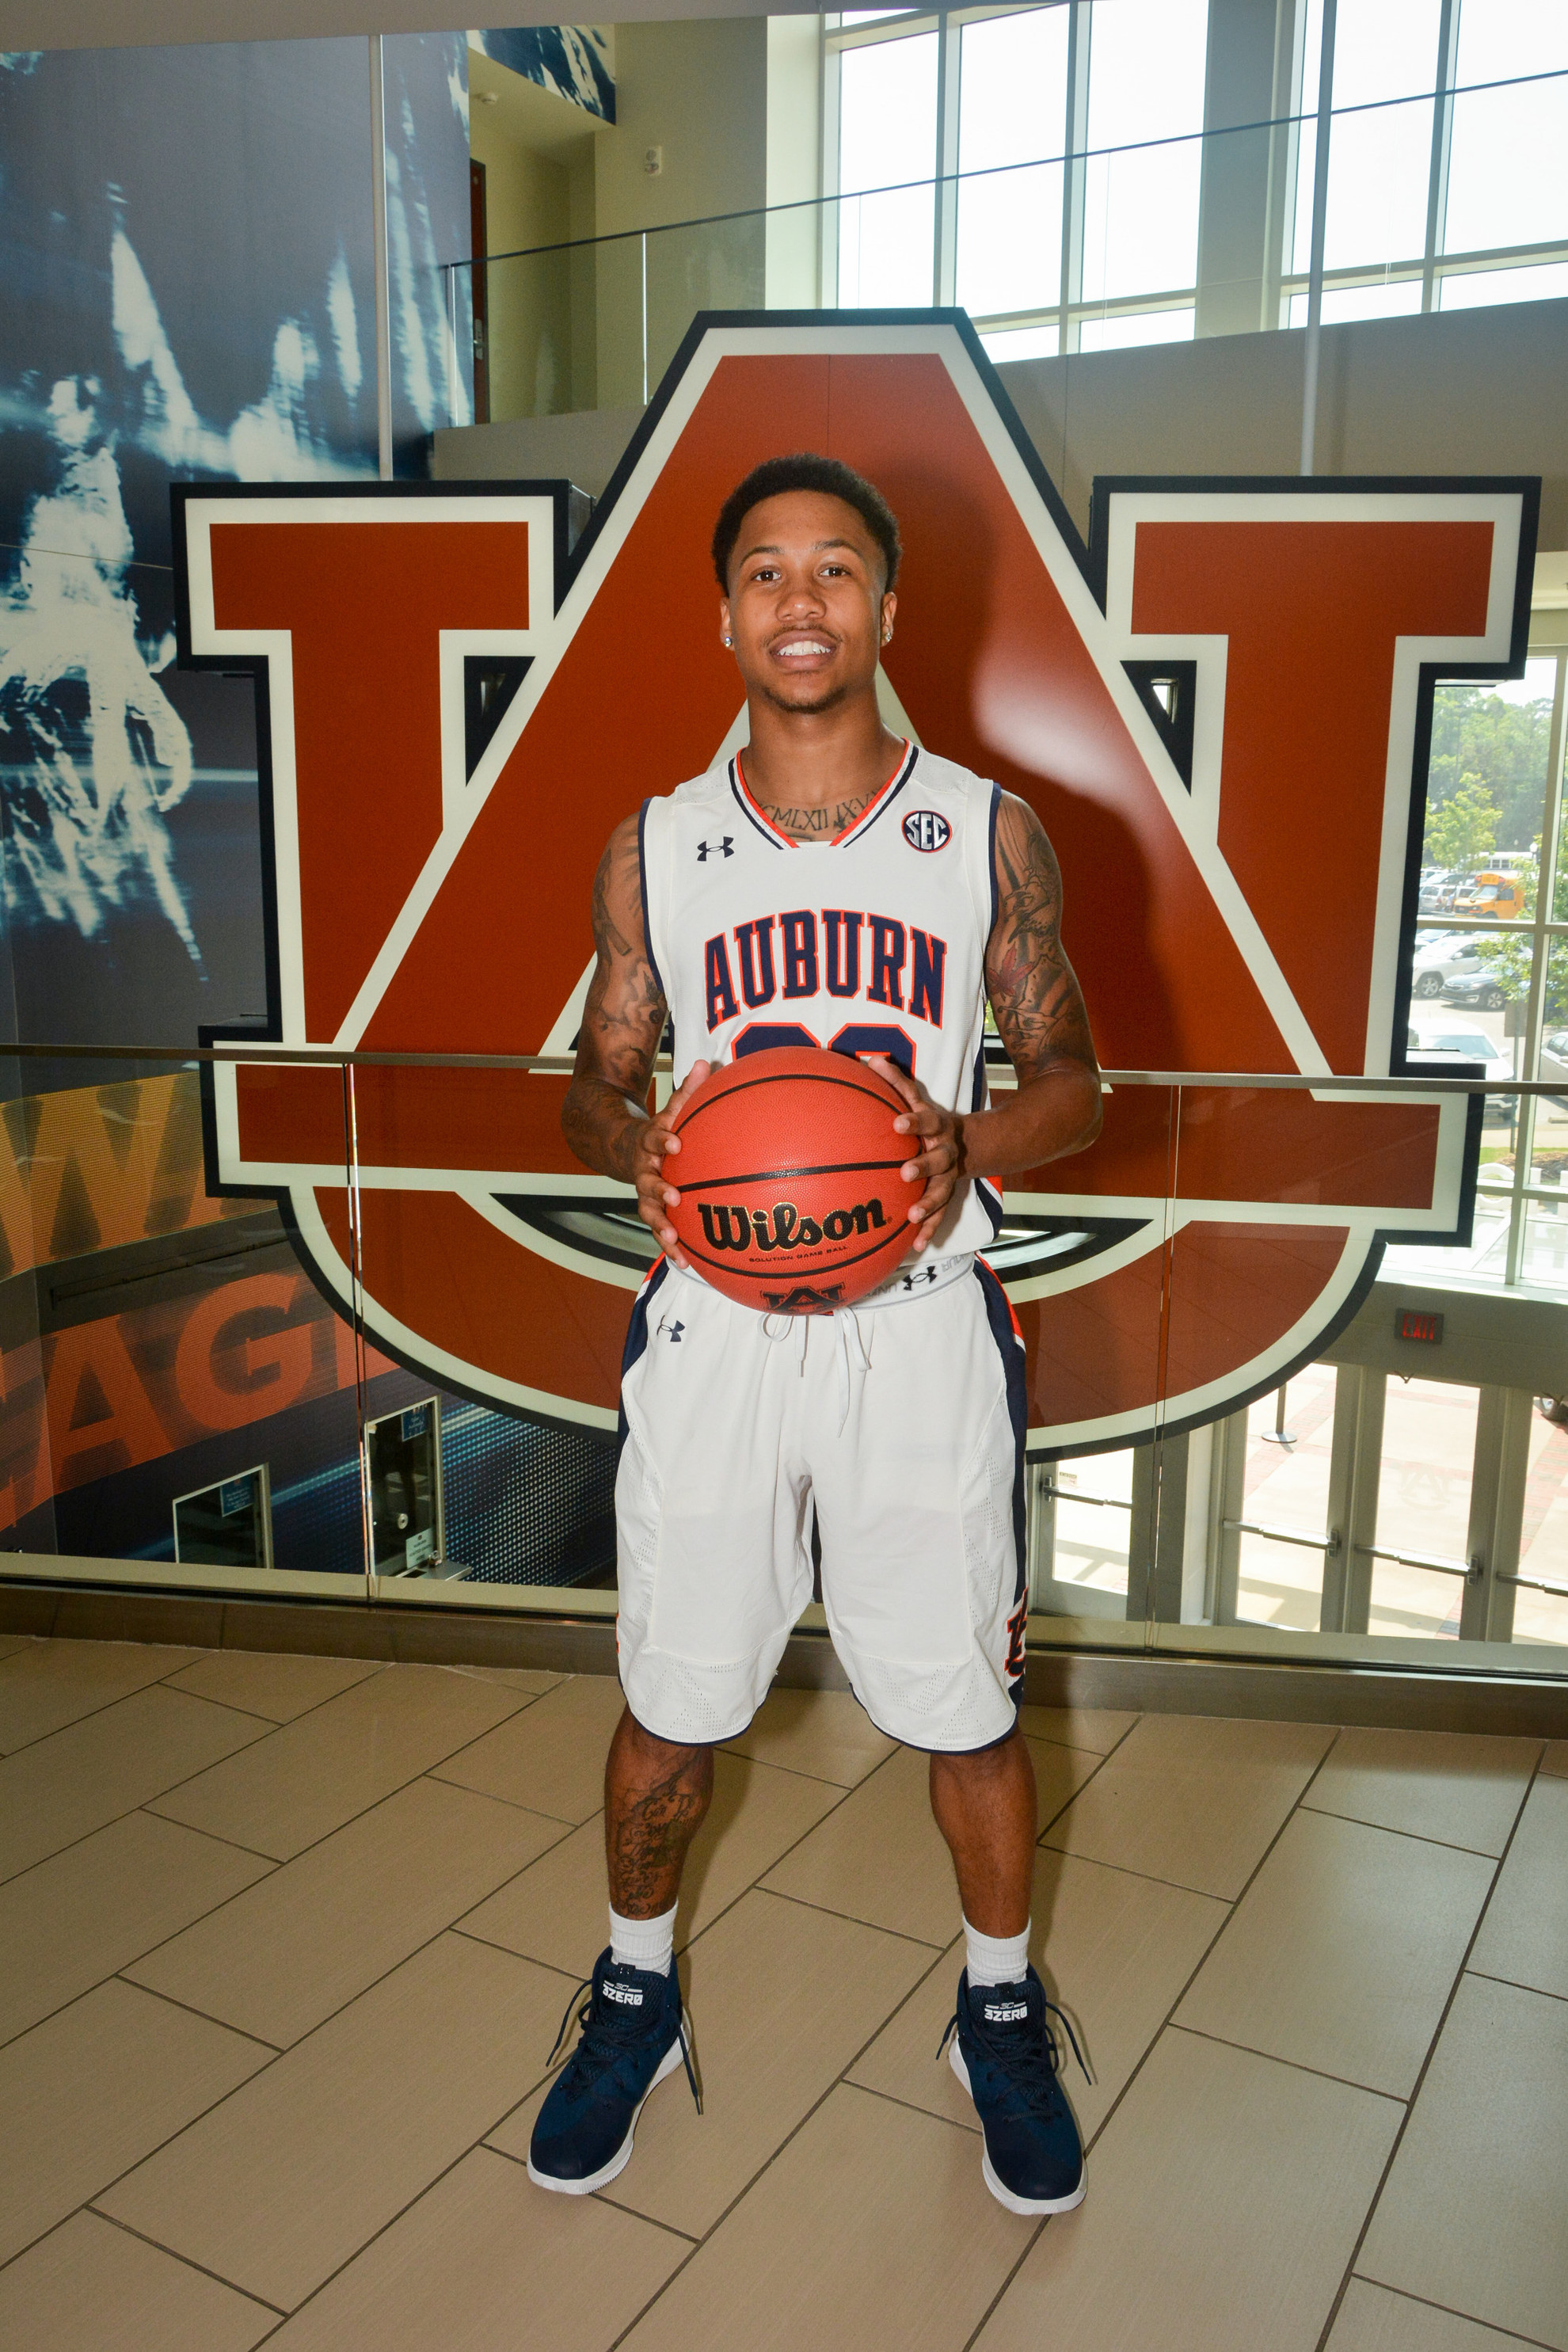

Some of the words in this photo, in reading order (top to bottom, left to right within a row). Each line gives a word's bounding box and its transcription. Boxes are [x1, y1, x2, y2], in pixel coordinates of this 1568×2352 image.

[905, 813, 948, 849] SEC
[704, 908, 947, 1034] AUBURN
[697, 1198, 888, 1253] Wilson
[1402, 1311, 1437, 1341] EXIT
